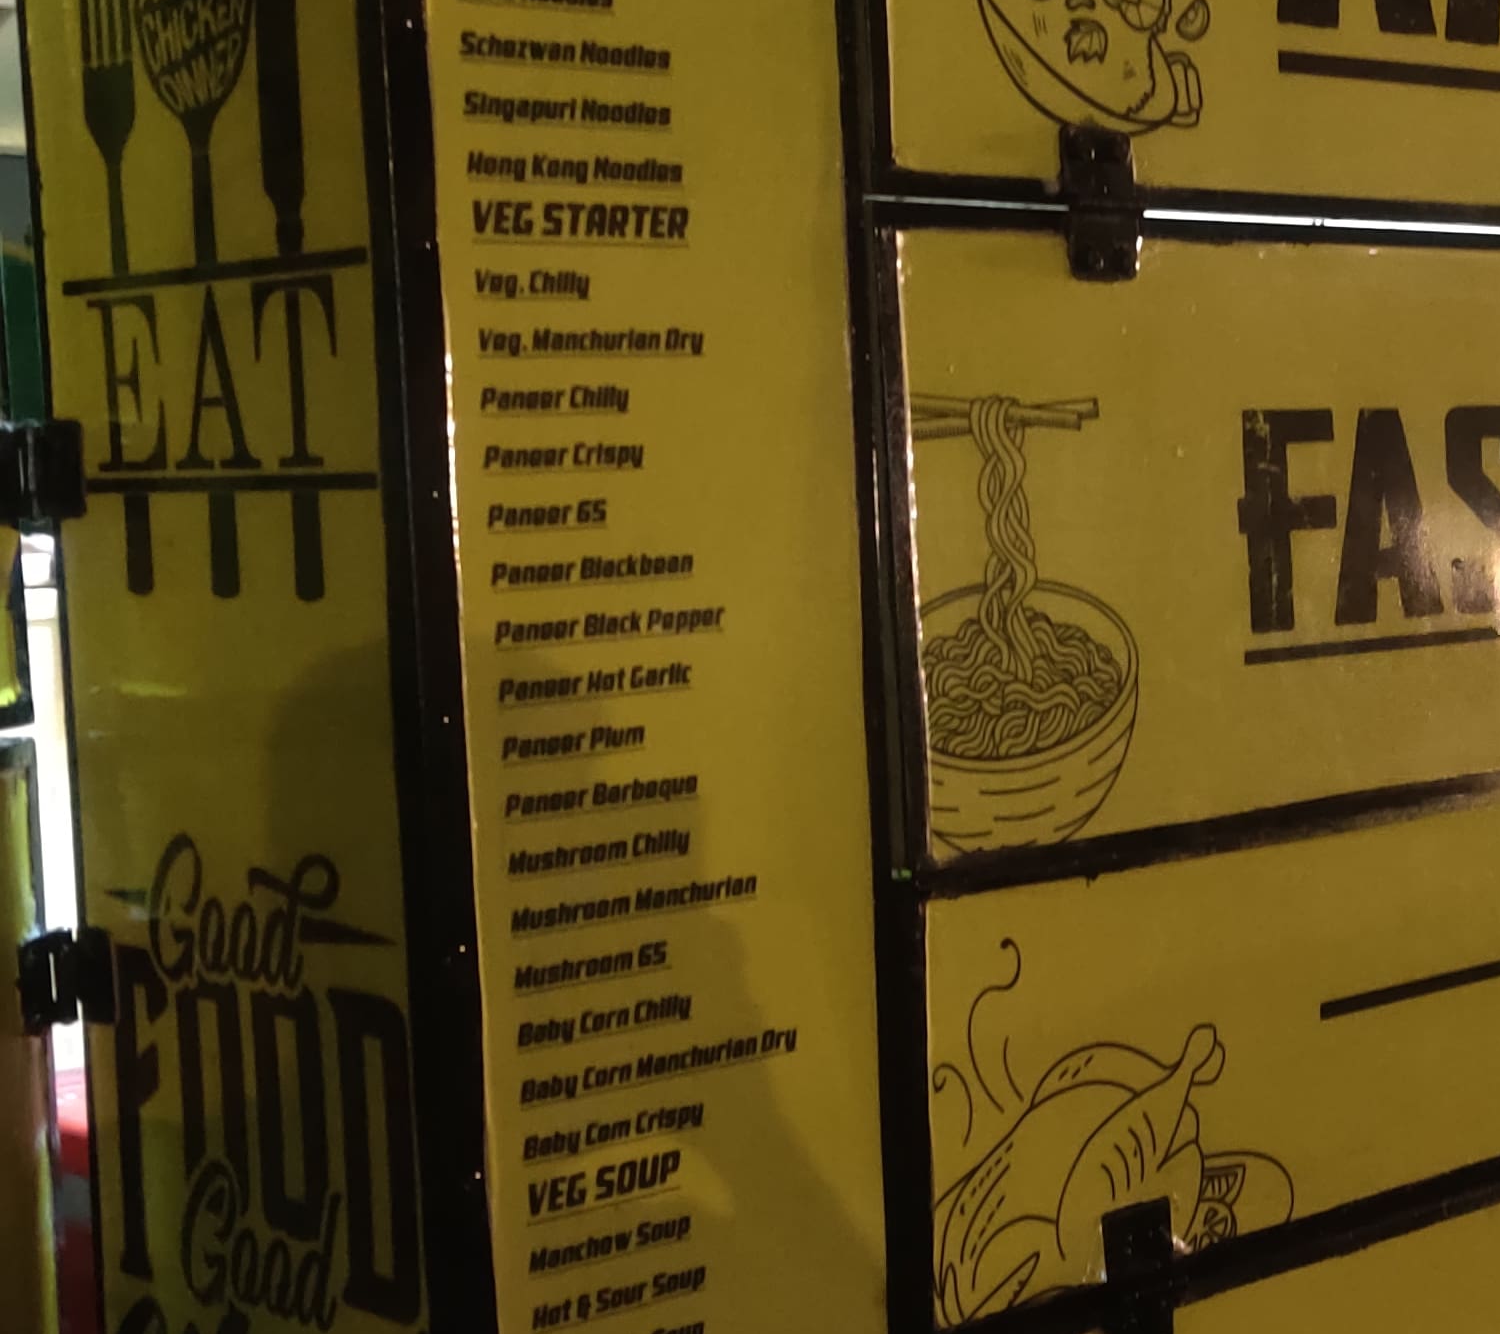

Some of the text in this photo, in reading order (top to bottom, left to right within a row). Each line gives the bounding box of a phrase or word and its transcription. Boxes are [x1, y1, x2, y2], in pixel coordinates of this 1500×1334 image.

[460, 32, 671, 69] Schezwan Noodles
[463, 91, 671, 125] Singapuri Noodles
[468, 151, 682, 183] Hong Kong Noodles
[472, 200, 689, 240] VEG STARTER
[529, 270, 590, 299] Chilly
[532, 328, 660, 353] Manchurian
[666, 330, 703, 355] Dry
[86, 273, 339, 472] EAT
[481, 385, 629, 412] Paneer Chilly
[484, 442, 644, 468] Paneer Crispy
[488, 502, 572, 527] Paneer
[491, 553, 693, 586] Paneer Blackbean
[495, 606, 724, 645] Paneer Black Pepper
[499, 663, 692, 701] Paneer Hot Garlic
[503, 725, 645, 760] Paneer Plum
[505, 774, 698, 817] Paneer Barbeque
[508, 829, 690, 876] Mushroom Chilly
[150, 832, 340, 992] Good
[512, 874, 757, 933] Mushroom Manchurian
[514, 951, 633, 990] Mushroom
[518, 995, 692, 1047] Baby Corn Chilly
[521, 1027, 797, 1105] Baby Corn Manchurian Dry
[110, 944, 425, 1325] FOOD
[523, 1128, 580, 1161] Baby
[635, 1103, 703, 1135] Crispy
[528, 1149, 681, 1216] VEG SOUP
[181, 1159, 342, 1332] Good
[529, 1214, 691, 1274] Manchow Soup
[533, 1266, 706, 1331] Hot & Sour Soup
